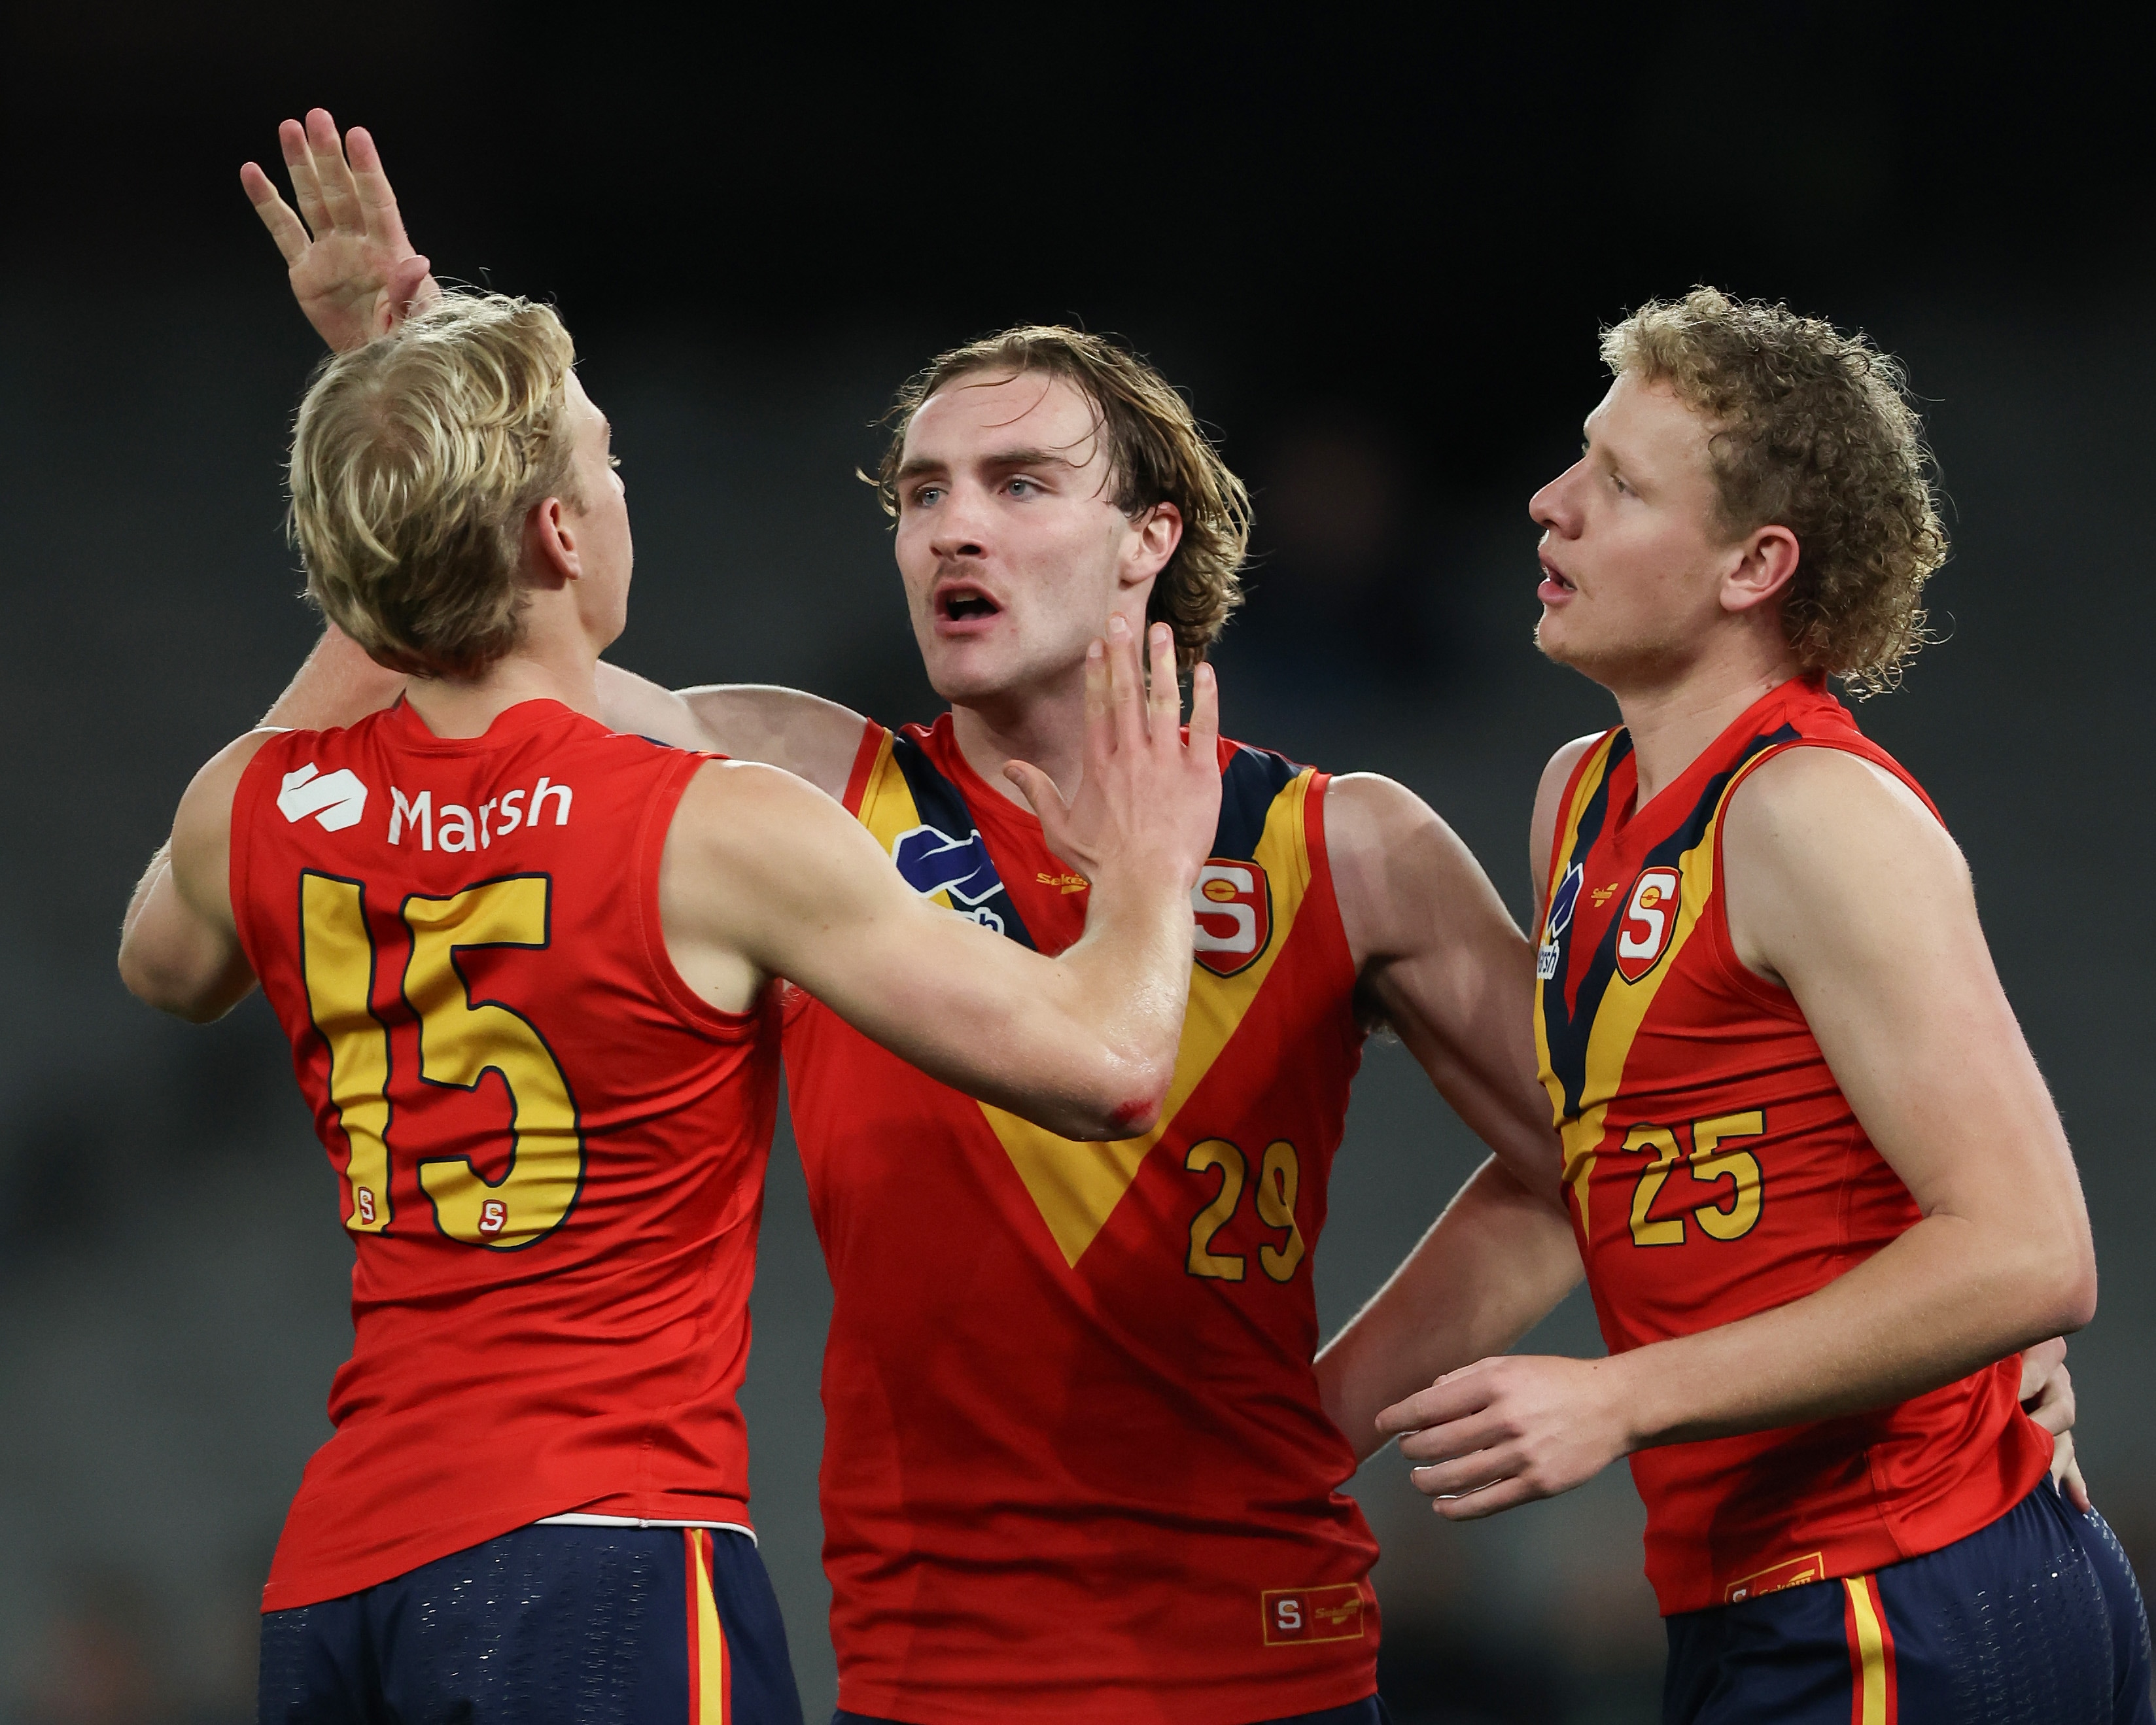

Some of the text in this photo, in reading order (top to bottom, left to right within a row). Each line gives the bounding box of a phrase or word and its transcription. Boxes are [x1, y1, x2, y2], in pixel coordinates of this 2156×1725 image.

[387, 776, 573, 853] Marsh
[1191, 865, 1257, 954] S
[1618, 873, 1677, 960] S
[299, 868, 586, 1253] 15
[360, 1190, 374, 1221] S
[479, 1202, 504, 1231] S
[1184, 1136, 1306, 1283] 29
[1620, 1107, 1767, 1248] 25
[1278, 1599, 1301, 1629] S
